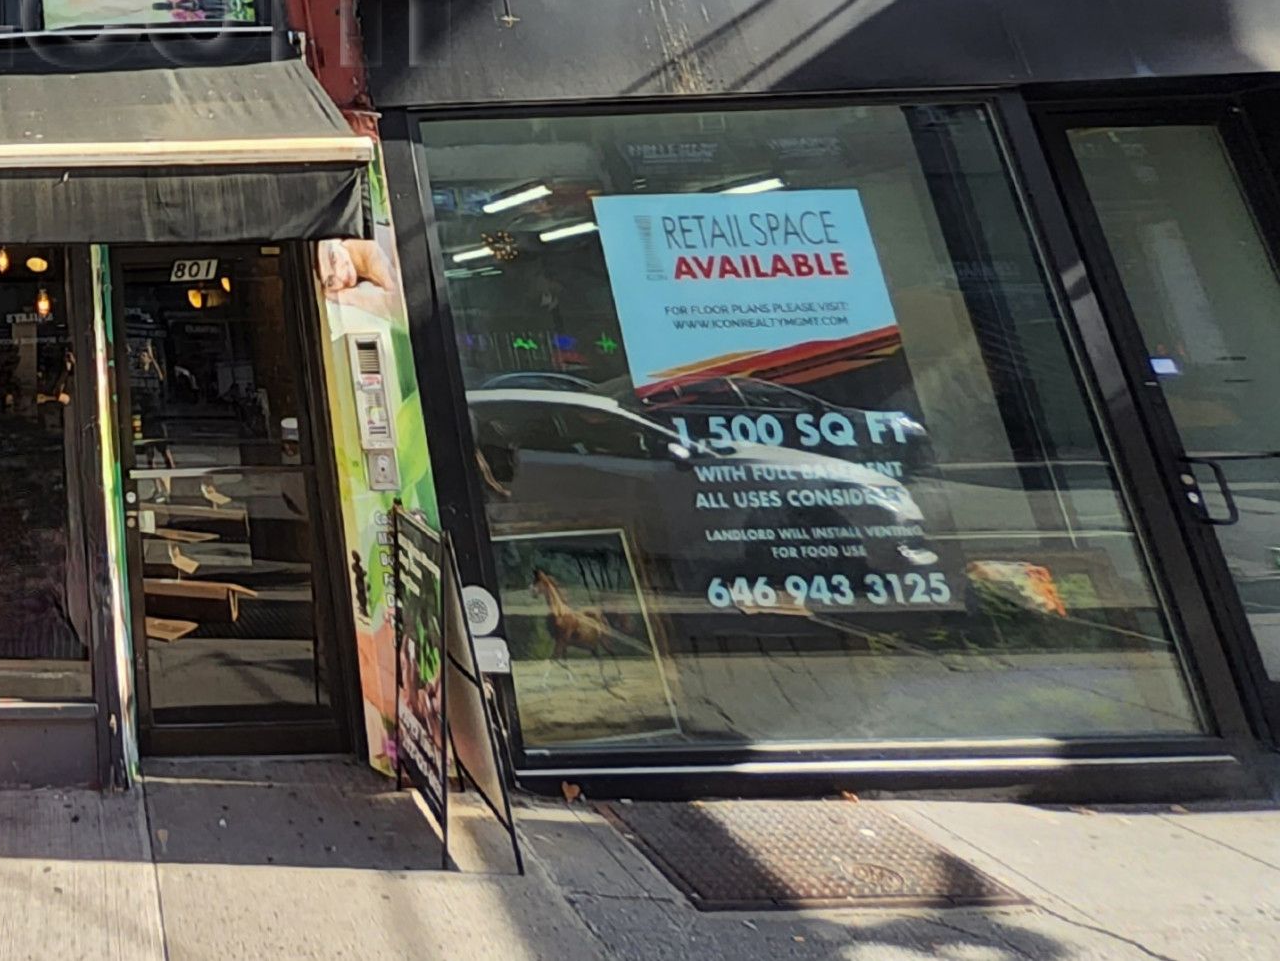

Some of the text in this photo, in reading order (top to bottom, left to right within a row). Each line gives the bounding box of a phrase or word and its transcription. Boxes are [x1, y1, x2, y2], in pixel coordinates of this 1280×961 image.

[662, 211, 839, 249] RETAIL SPACE
[173, 261, 213, 279] 801
[674, 252, 849, 280] AVAILABLE
[664, 305, 688, 317] FOR
[691, 304, 729, 315] FLOOR
[732, 303, 770, 315] PLANS
[795, 412, 858, 447] SQ
[864, 411, 908, 445] FT
[694, 464, 746, 482] WITH
[695, 492, 730, 509] ALL
[733, 490, 782, 508] USES
[705, 528, 775, 542] LANDLORD
[772, 546, 798, 559] FOR
[801, 545, 838, 558] FOOD
[707, 572, 951, 608] 646 943 3125
